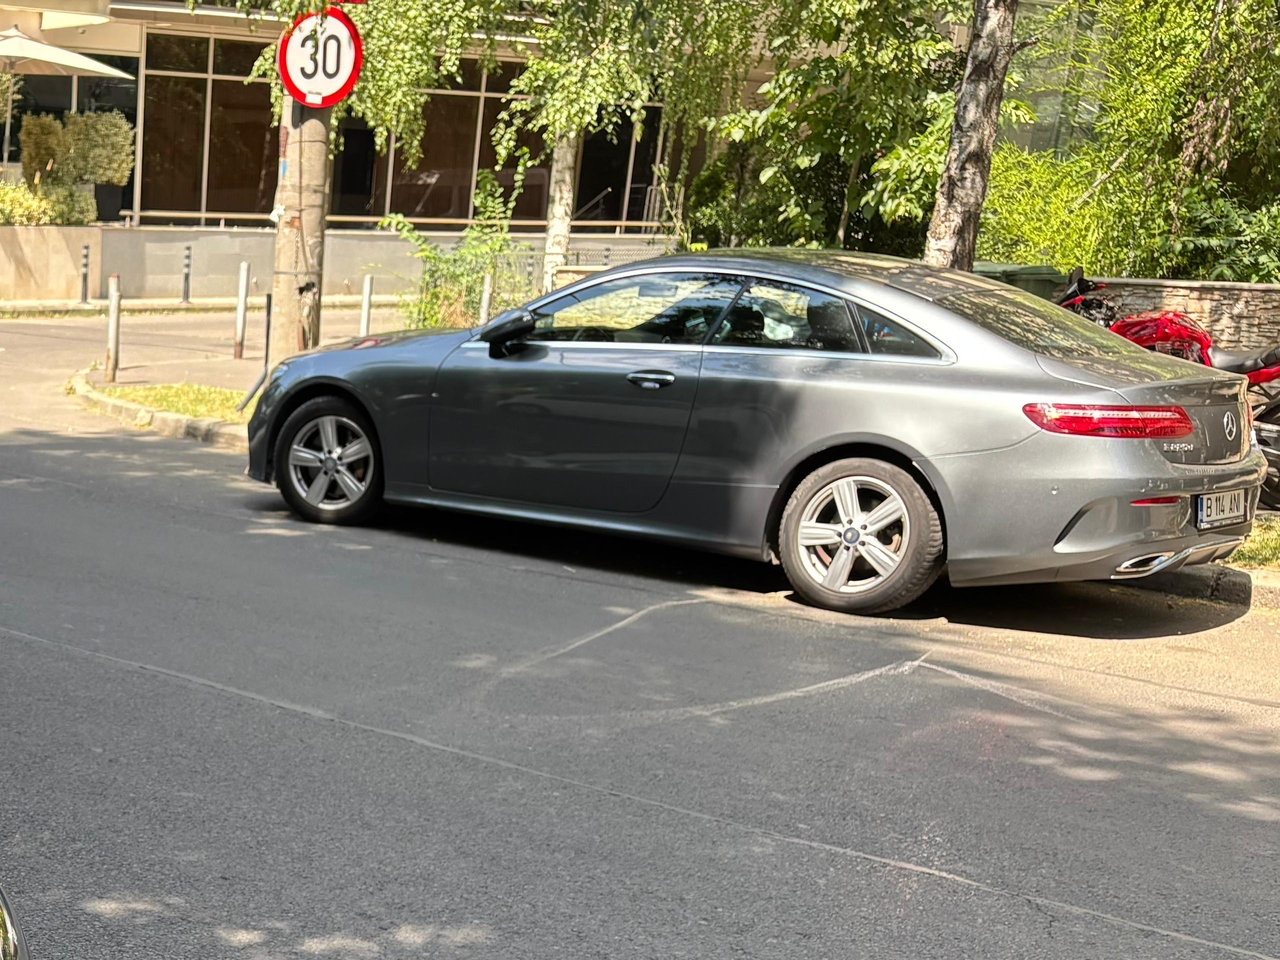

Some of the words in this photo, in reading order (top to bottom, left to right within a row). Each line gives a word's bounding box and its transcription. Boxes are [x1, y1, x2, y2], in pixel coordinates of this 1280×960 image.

[300, 34, 341, 80] 30
[1206, 496, 1213, 518] B
[1215, 494, 1225, 517] 114
